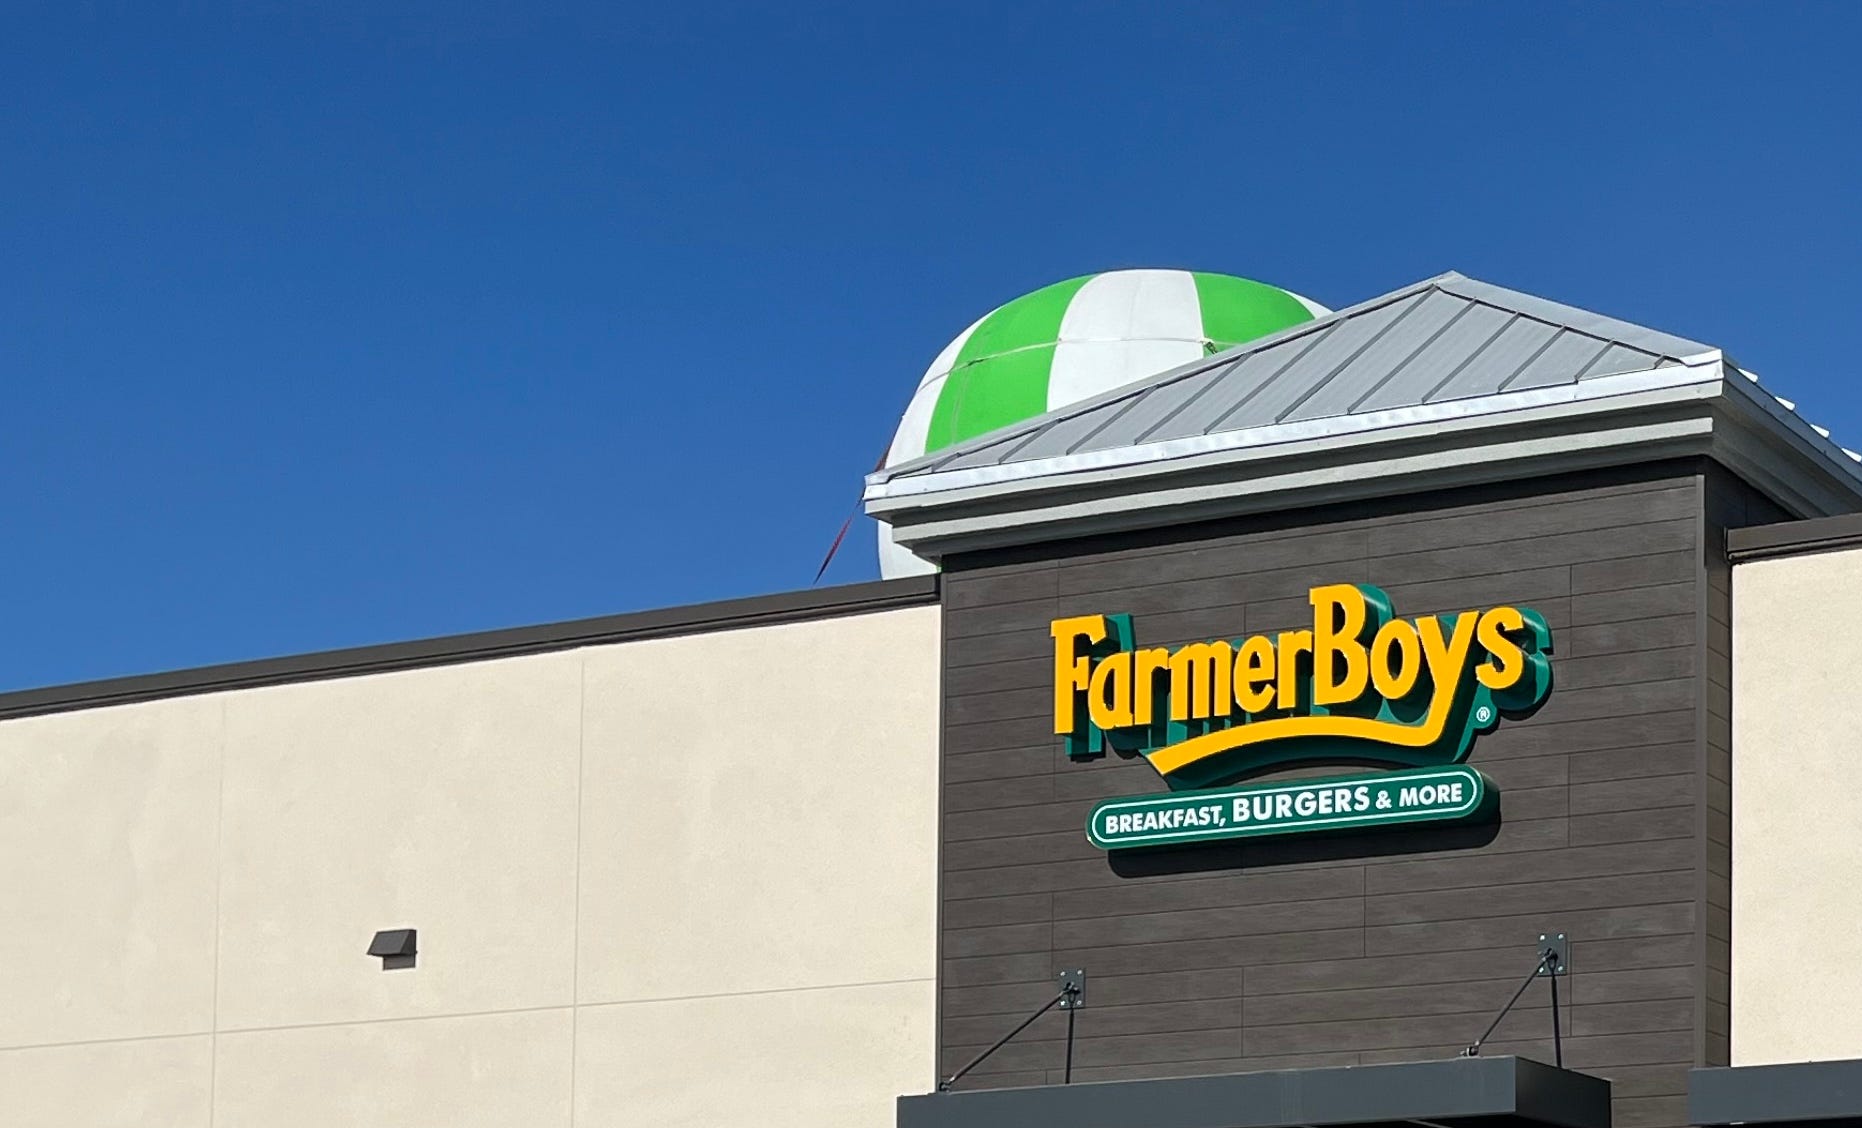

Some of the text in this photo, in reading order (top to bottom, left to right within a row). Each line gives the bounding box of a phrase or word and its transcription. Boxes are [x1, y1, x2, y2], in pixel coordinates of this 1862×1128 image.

[1105, 783, 1463, 835] BREAKFAST, BURGERS & MORE
